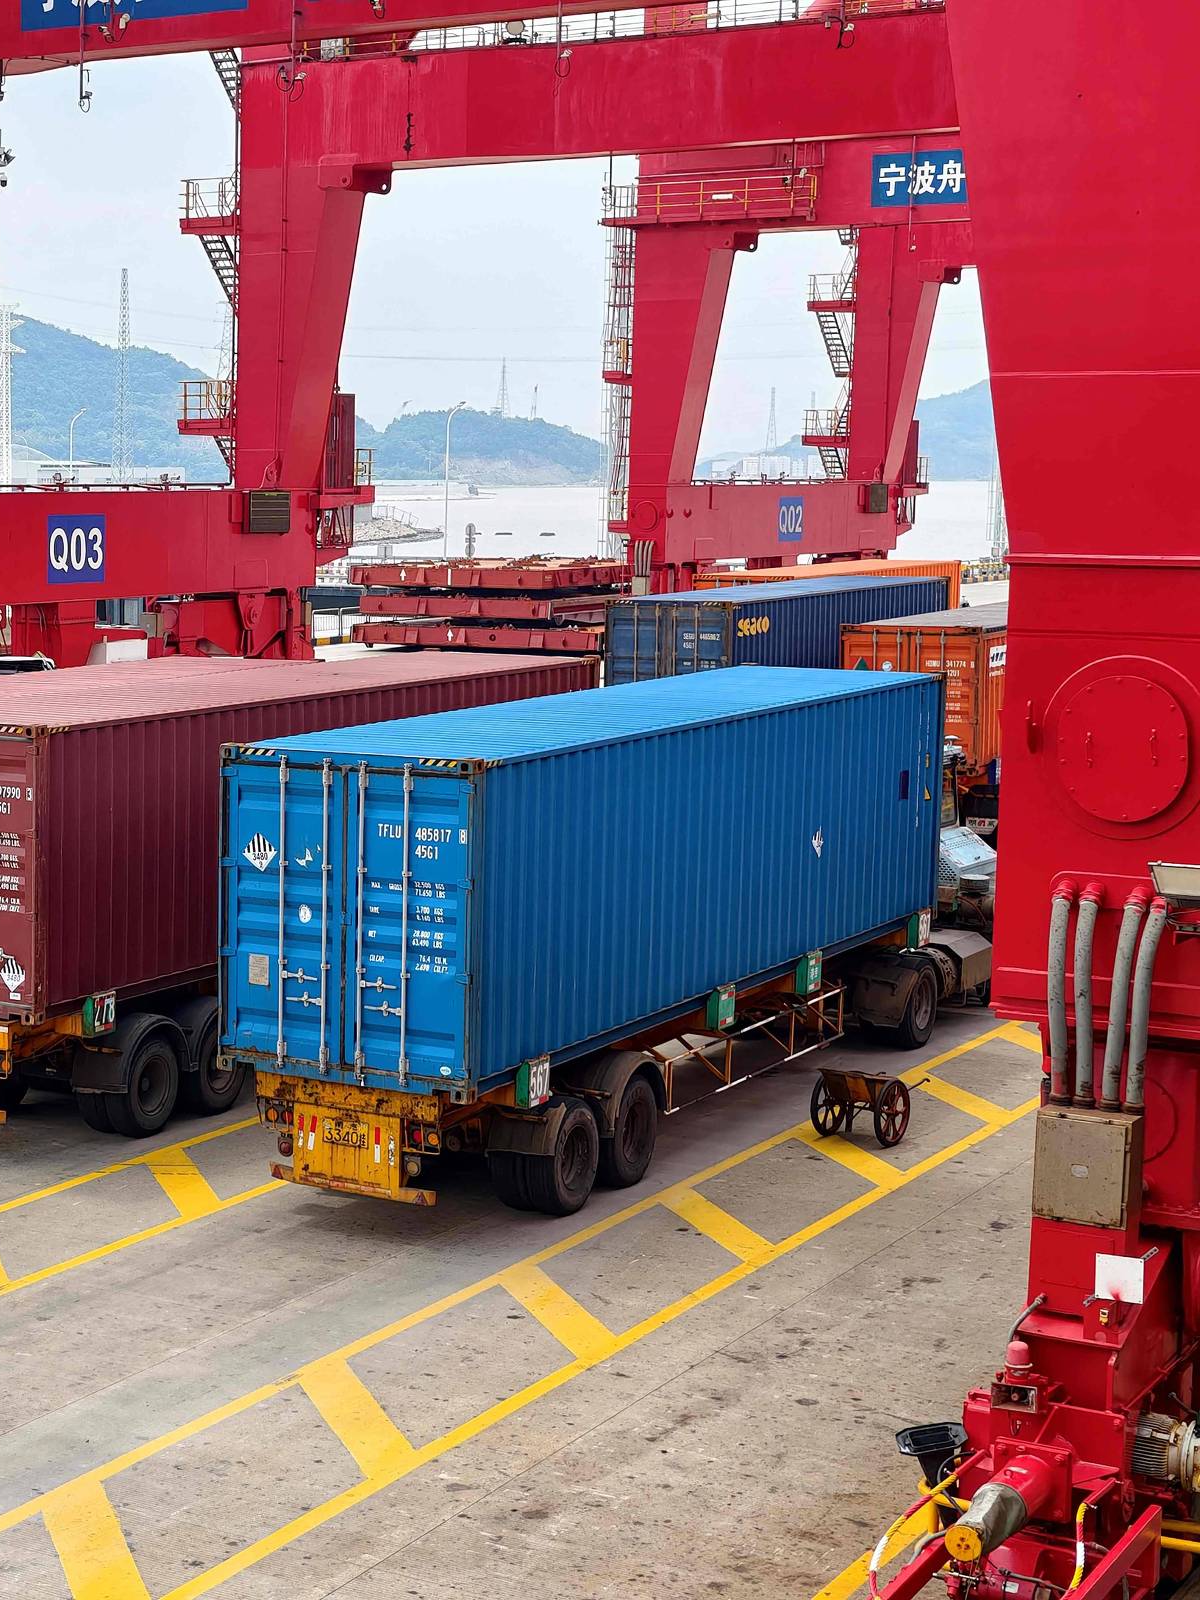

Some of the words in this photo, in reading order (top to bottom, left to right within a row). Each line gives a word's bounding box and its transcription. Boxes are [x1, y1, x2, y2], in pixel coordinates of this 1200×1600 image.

[879, 160, 966, 197] 宁波舟
[779, 505, 803, 535] Q02
[49, 527, 104, 573] Q03
[737, 615, 770, 637] seaco
[945, 660, 967, 669] 341774
[25, 787, 33, 802] 3
[377, 823, 402, 839] TFLU
[414, 827, 452, 843] 485817
[458, 829, 468, 845] 8
[252, 852, 269, 861] 3480
[414, 845, 439, 860] 45G1
[436, 890, 446, 899] LBS
[432, 940, 443, 949] LBS
[530, 1062, 550, 1100] 567
